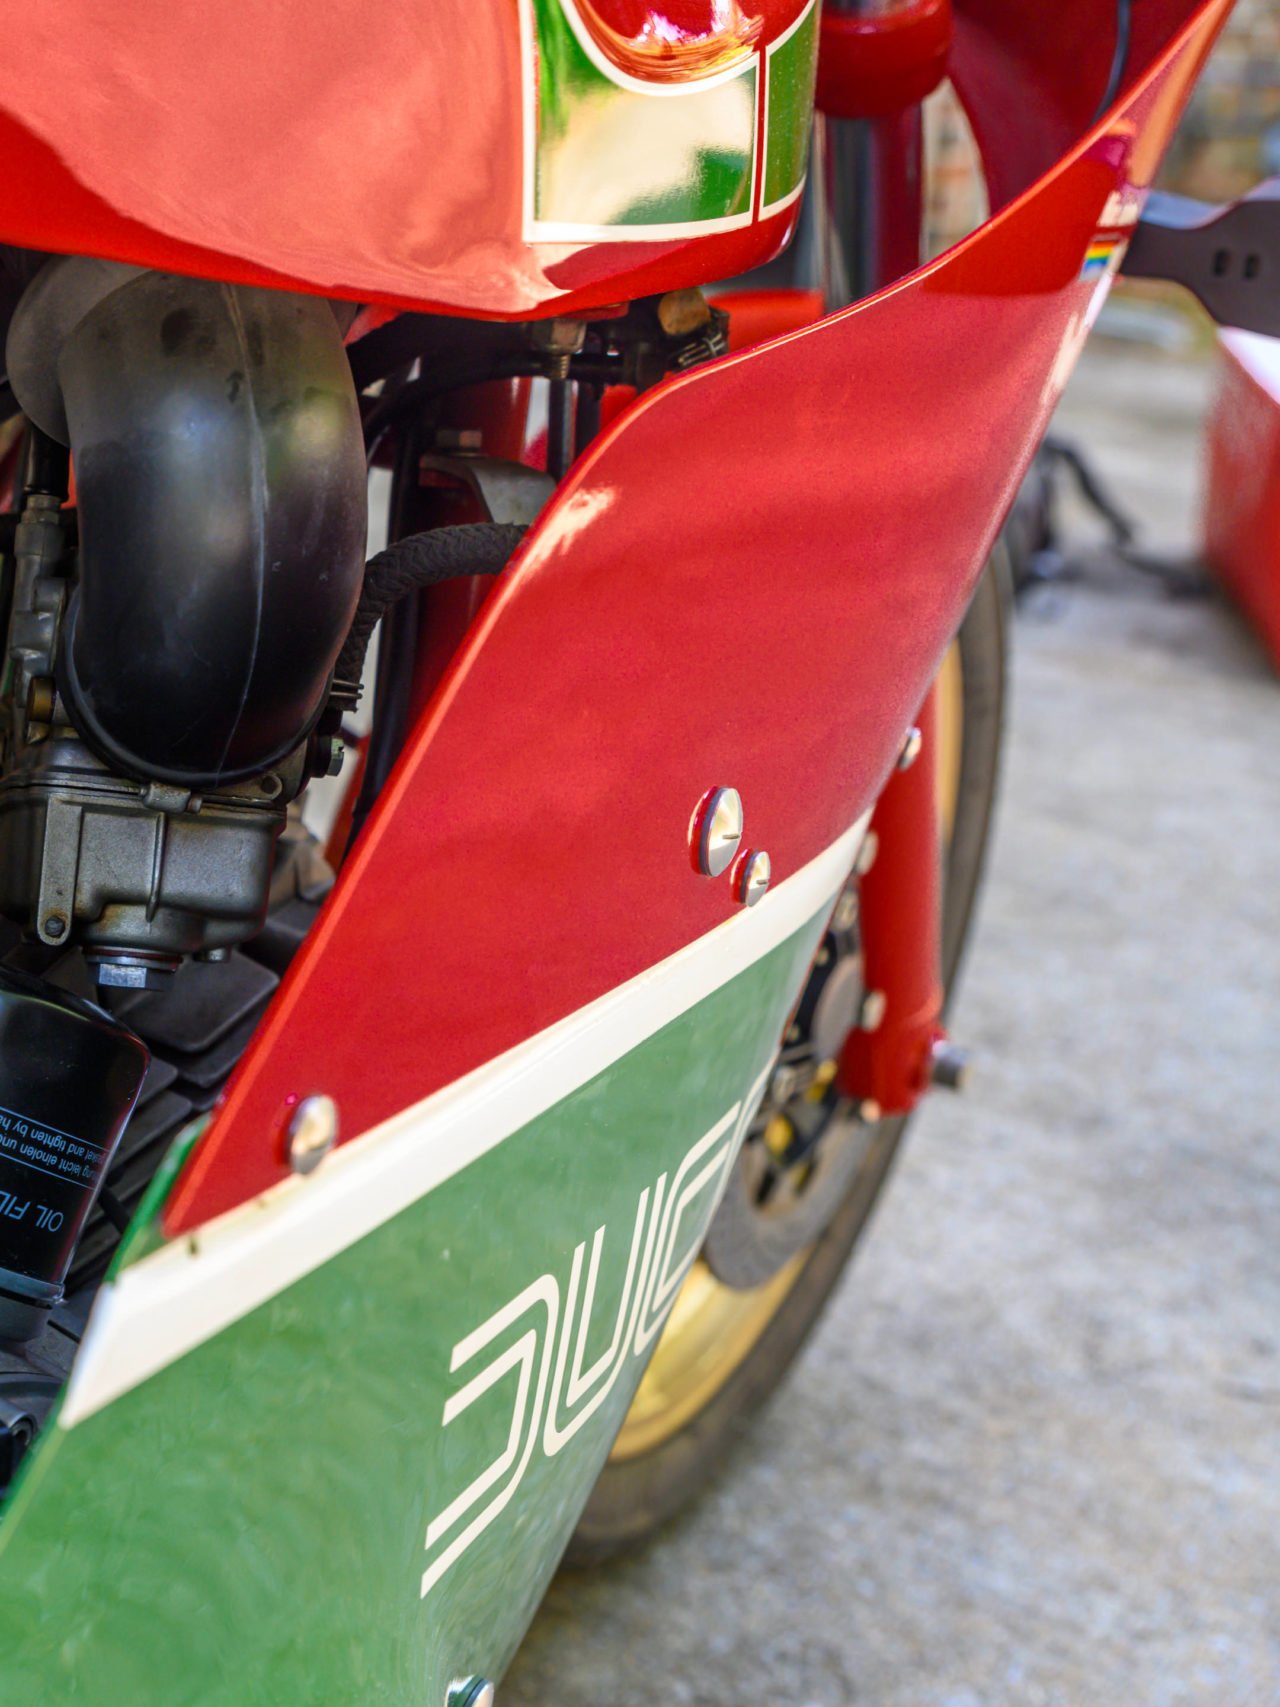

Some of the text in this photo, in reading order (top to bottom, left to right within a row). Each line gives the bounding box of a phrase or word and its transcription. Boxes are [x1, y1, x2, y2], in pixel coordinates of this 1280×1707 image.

[12, 1120, 29, 1136] by
[30, 1128, 67, 1153] tighten
[66, 1143, 86, 1158] and
[35, 1204, 64, 1232] OIL
